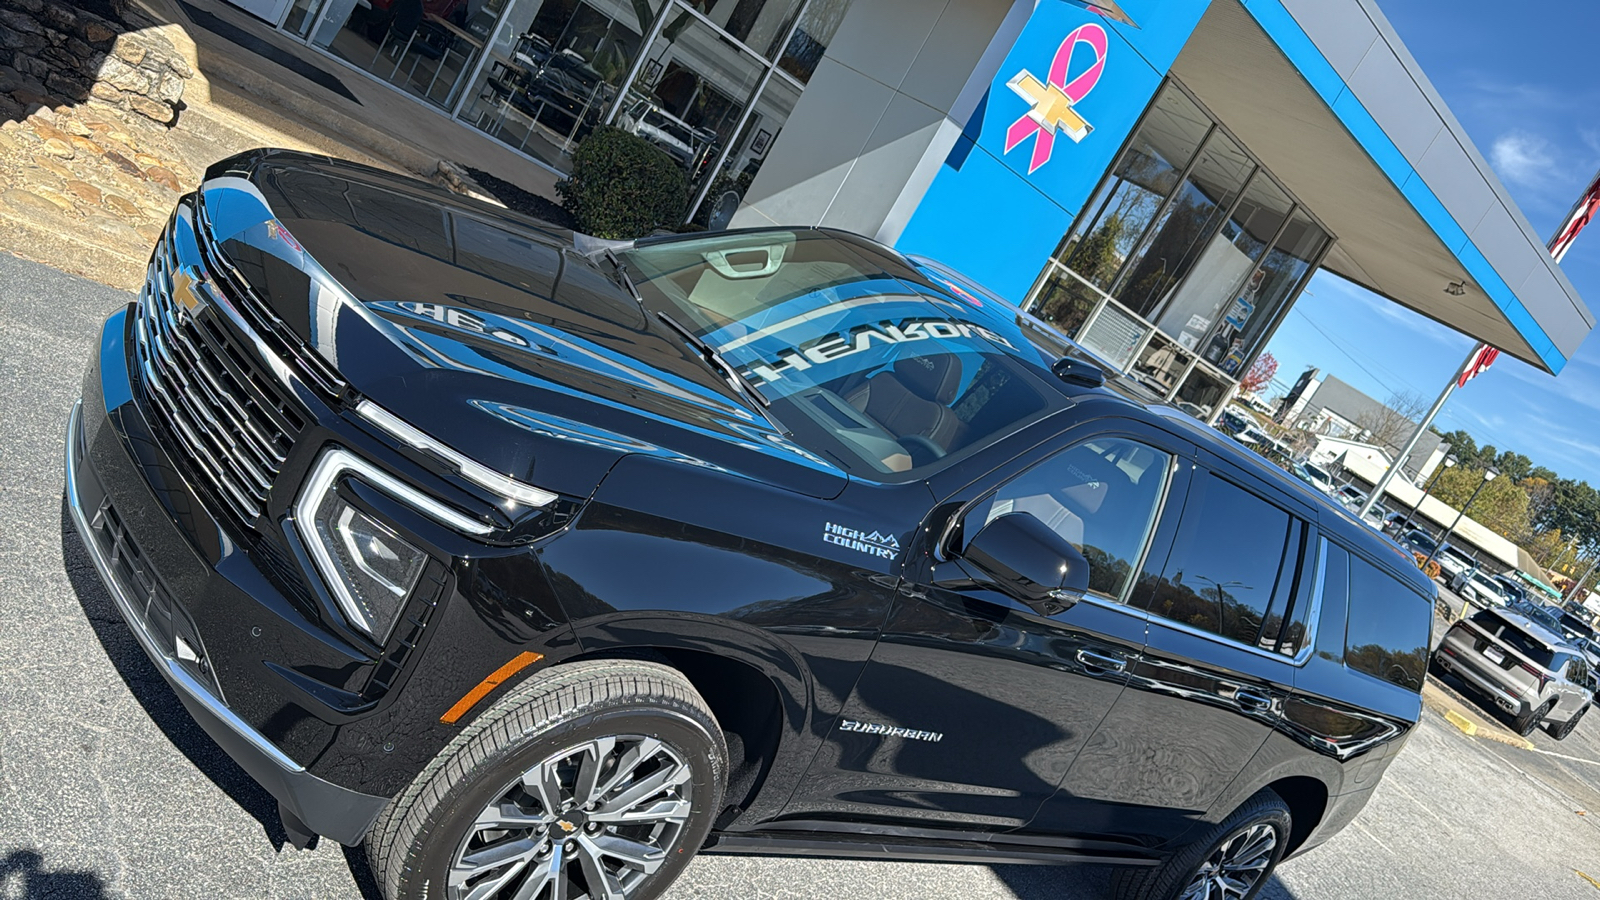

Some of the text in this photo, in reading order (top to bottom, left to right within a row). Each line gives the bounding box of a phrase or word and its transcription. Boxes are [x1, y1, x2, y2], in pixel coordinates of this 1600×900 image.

[824, 521, 866, 541] HIGH
[823, 533, 899, 560] COUNTRY
[839, 719, 944, 743] SUBURBAN
